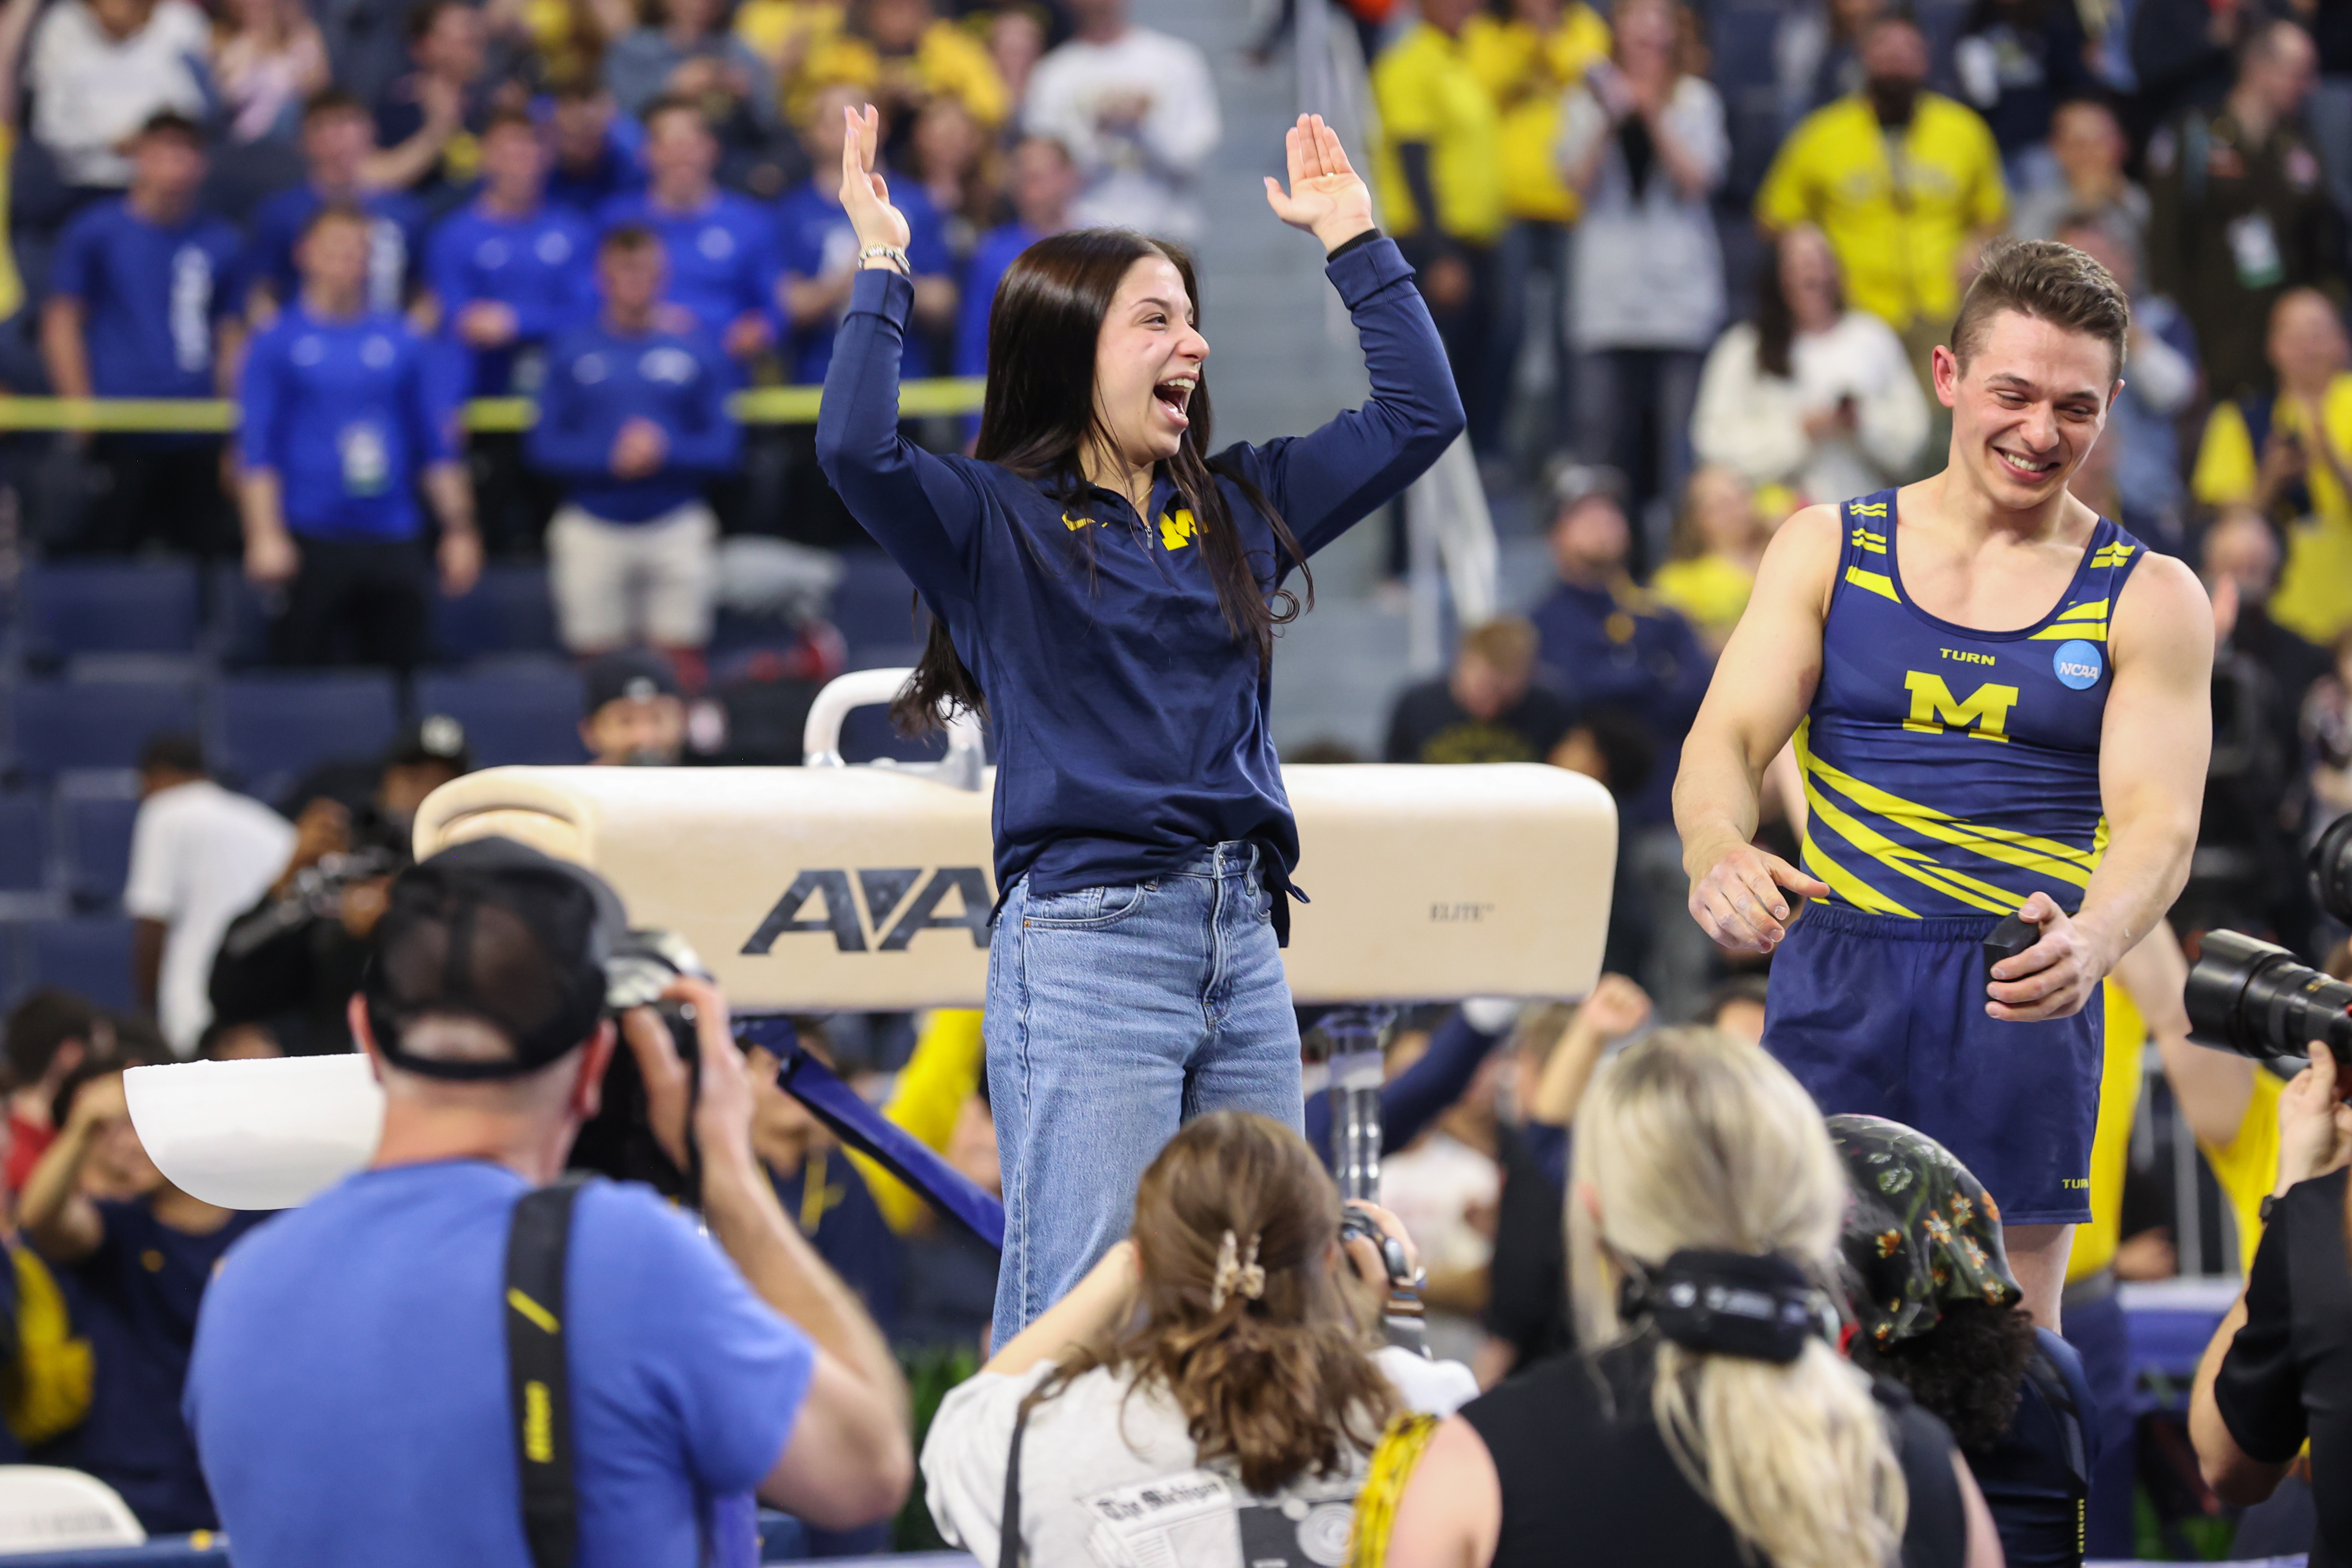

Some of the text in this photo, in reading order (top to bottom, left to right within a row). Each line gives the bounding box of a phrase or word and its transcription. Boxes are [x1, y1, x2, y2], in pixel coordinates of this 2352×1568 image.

[1939, 648, 1996, 666] TURN
[2059, 662, 2099, 680] NCAA
[1902, 670, 2019, 743] M
[2062, 1178, 2089, 1189] TUR
